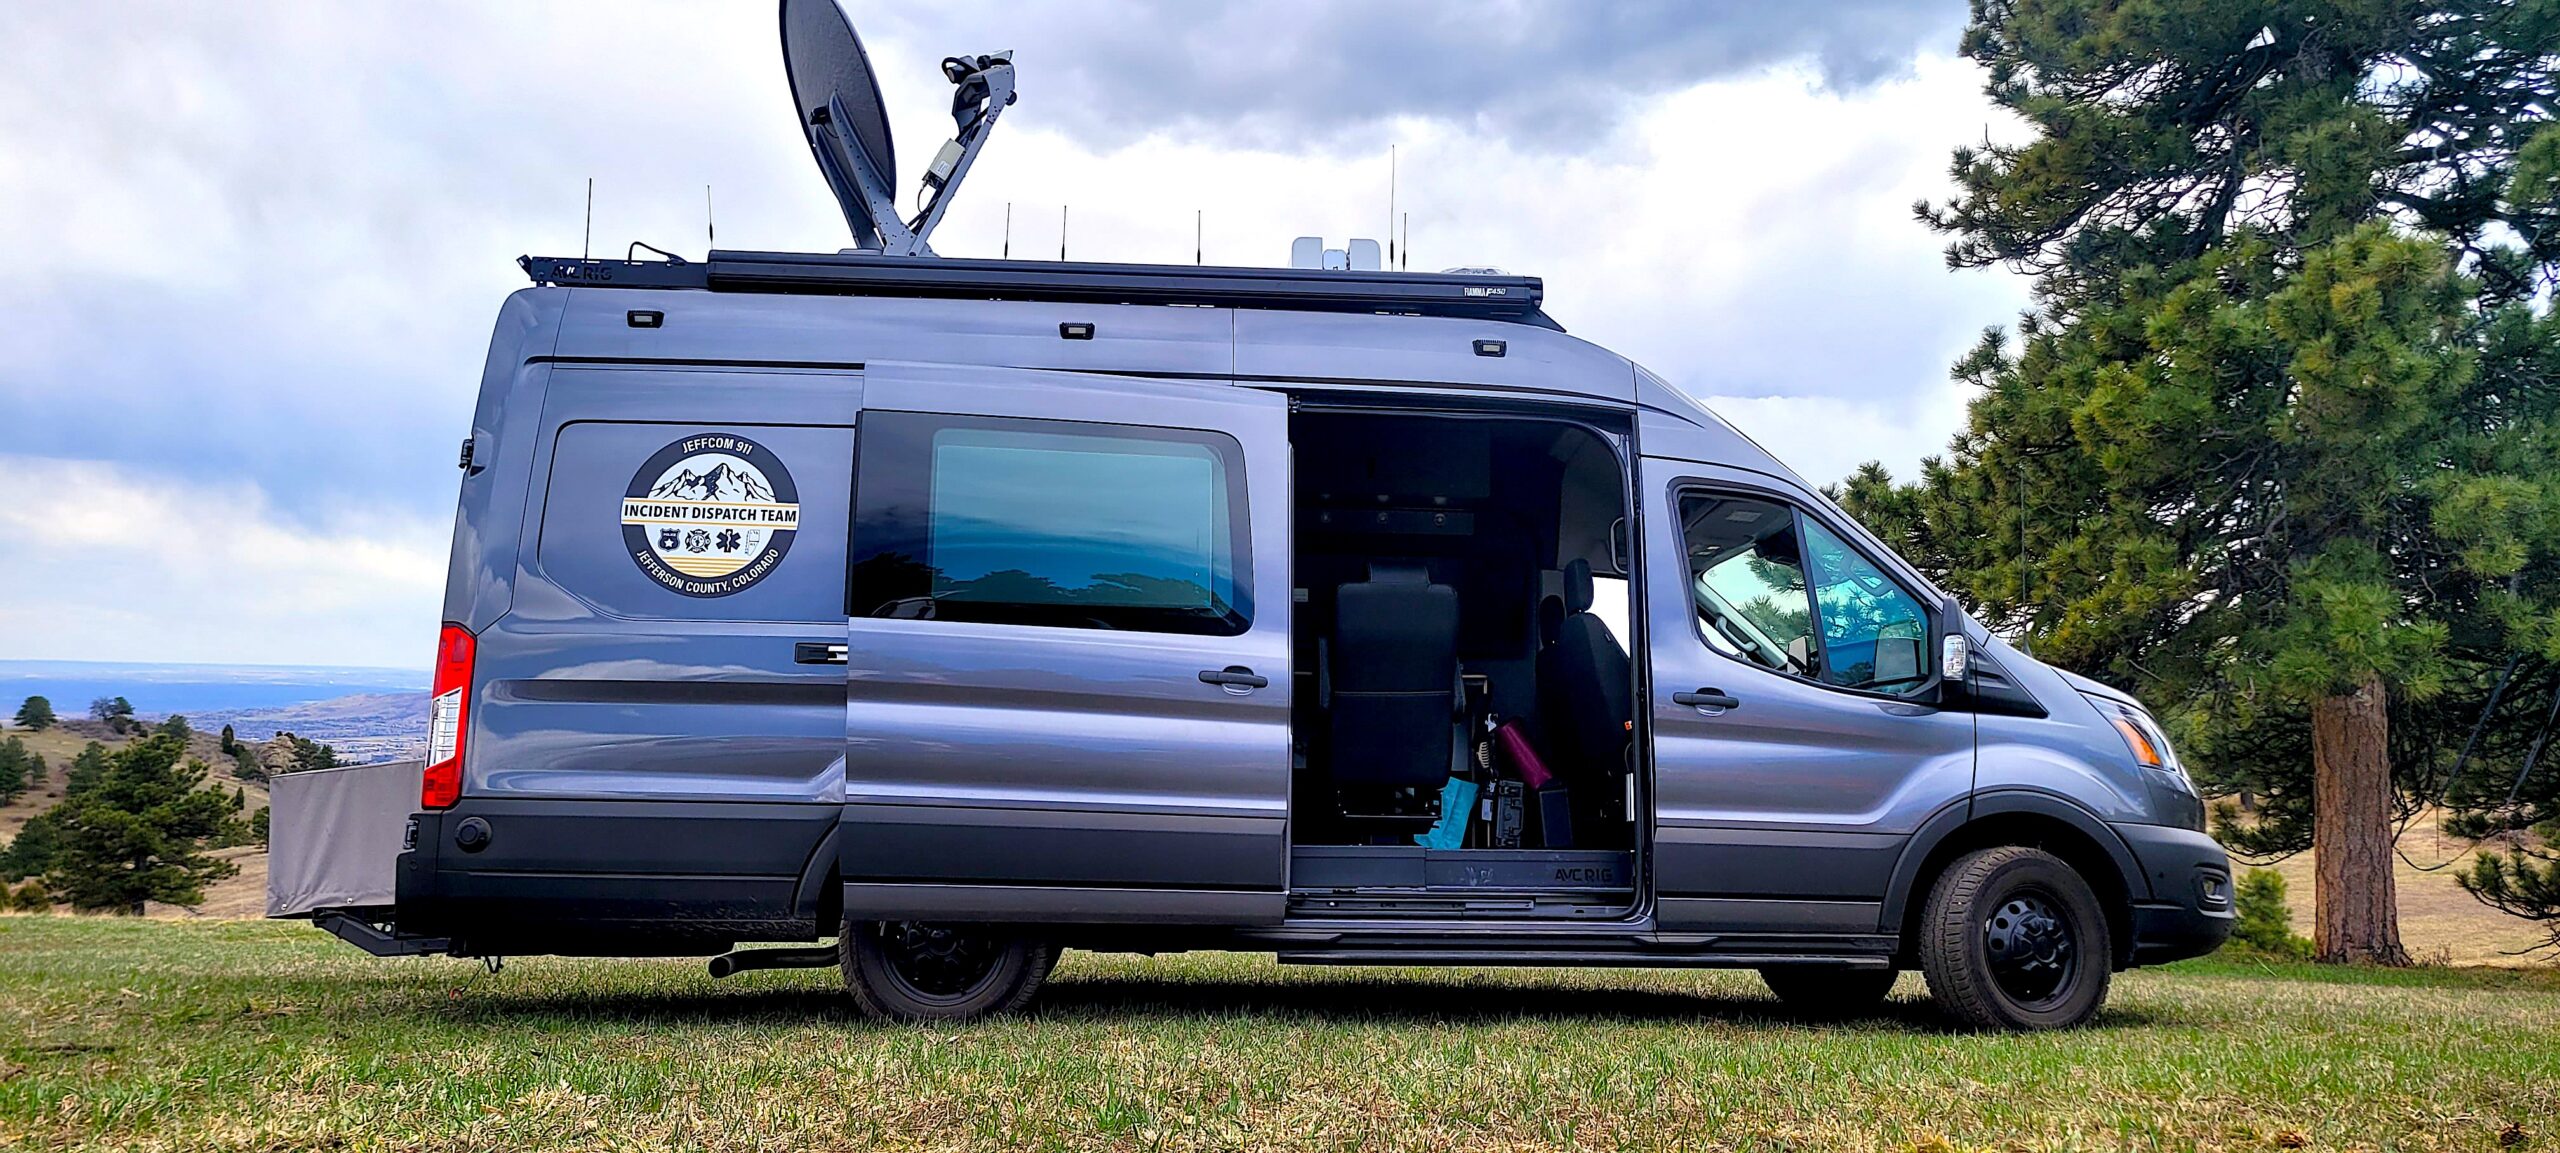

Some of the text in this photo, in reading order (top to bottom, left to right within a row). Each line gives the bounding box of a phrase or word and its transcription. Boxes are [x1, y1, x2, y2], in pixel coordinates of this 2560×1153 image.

[1464, 287, 1486, 297] FIAMMA
[682, 438, 753, 455] JEFFCOM 911
[624, 504, 797, 522] INCIDENT DISPATCH TEAM
[637, 548, 779, 594] JEFFERSON COUNTY, COLORADO
